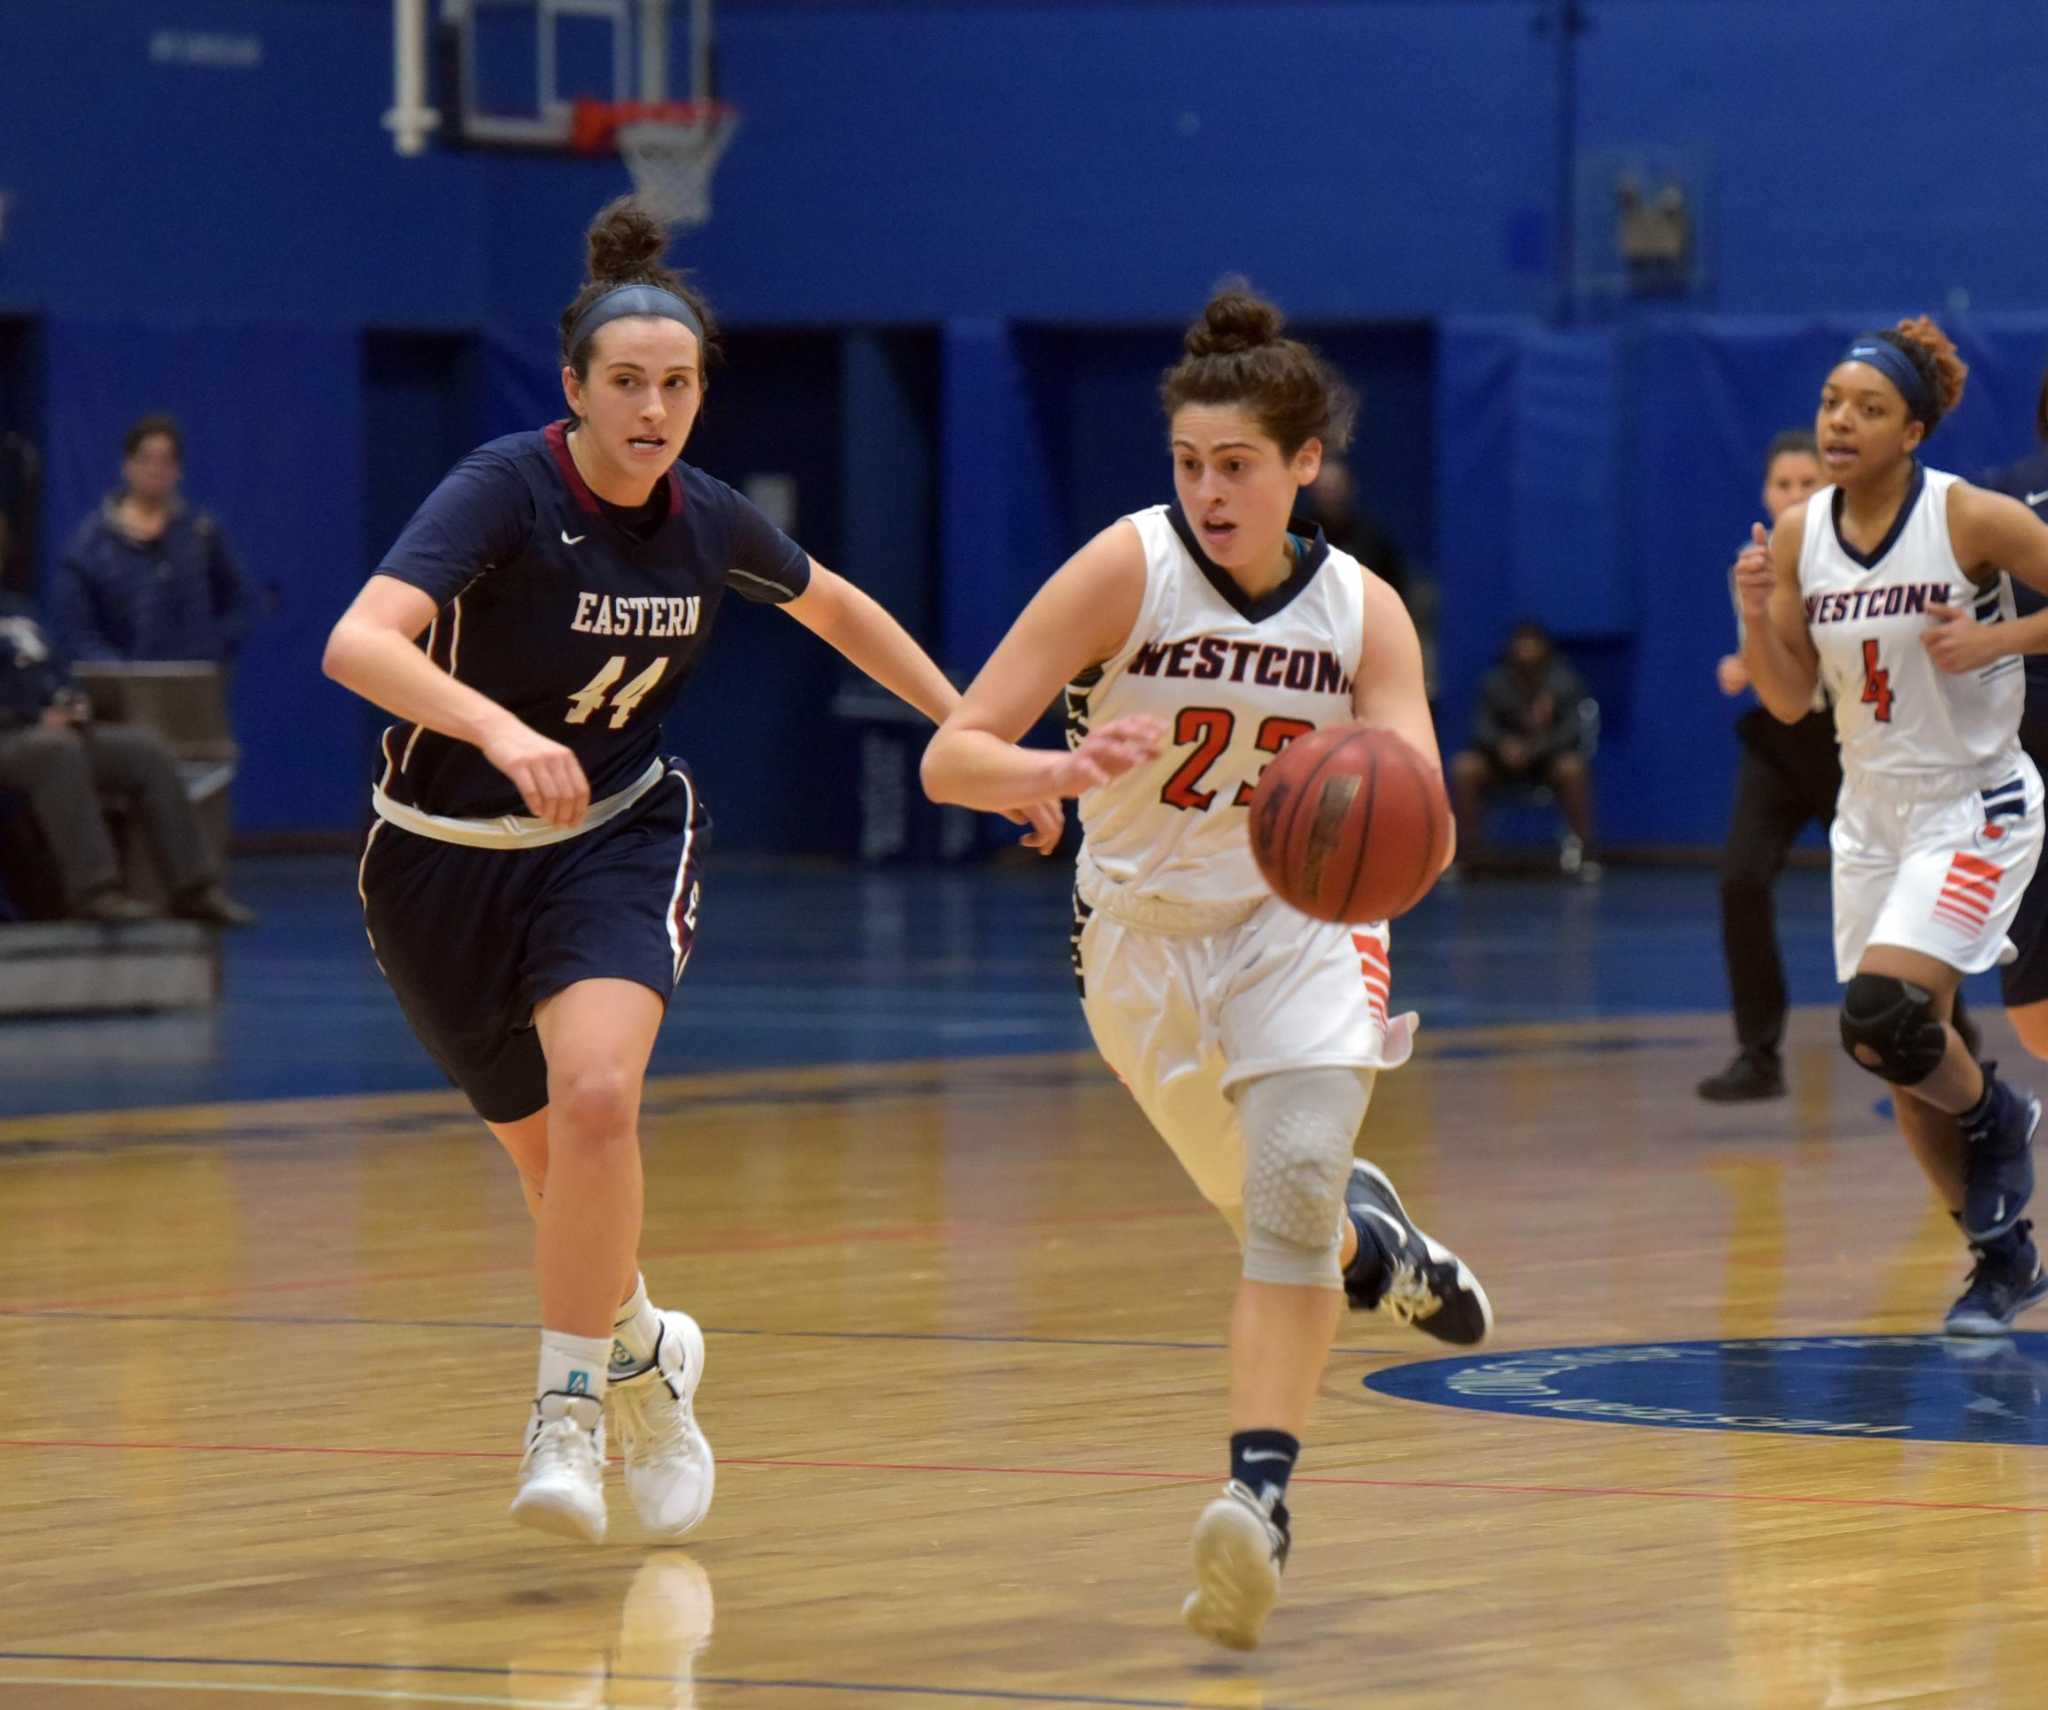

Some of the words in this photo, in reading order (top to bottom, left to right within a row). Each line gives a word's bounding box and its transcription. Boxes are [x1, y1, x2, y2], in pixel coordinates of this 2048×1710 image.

[570, 591, 701, 637] EASTERN
[564, 655, 670, 729] 44
[1861, 638, 1894, 723] 4
